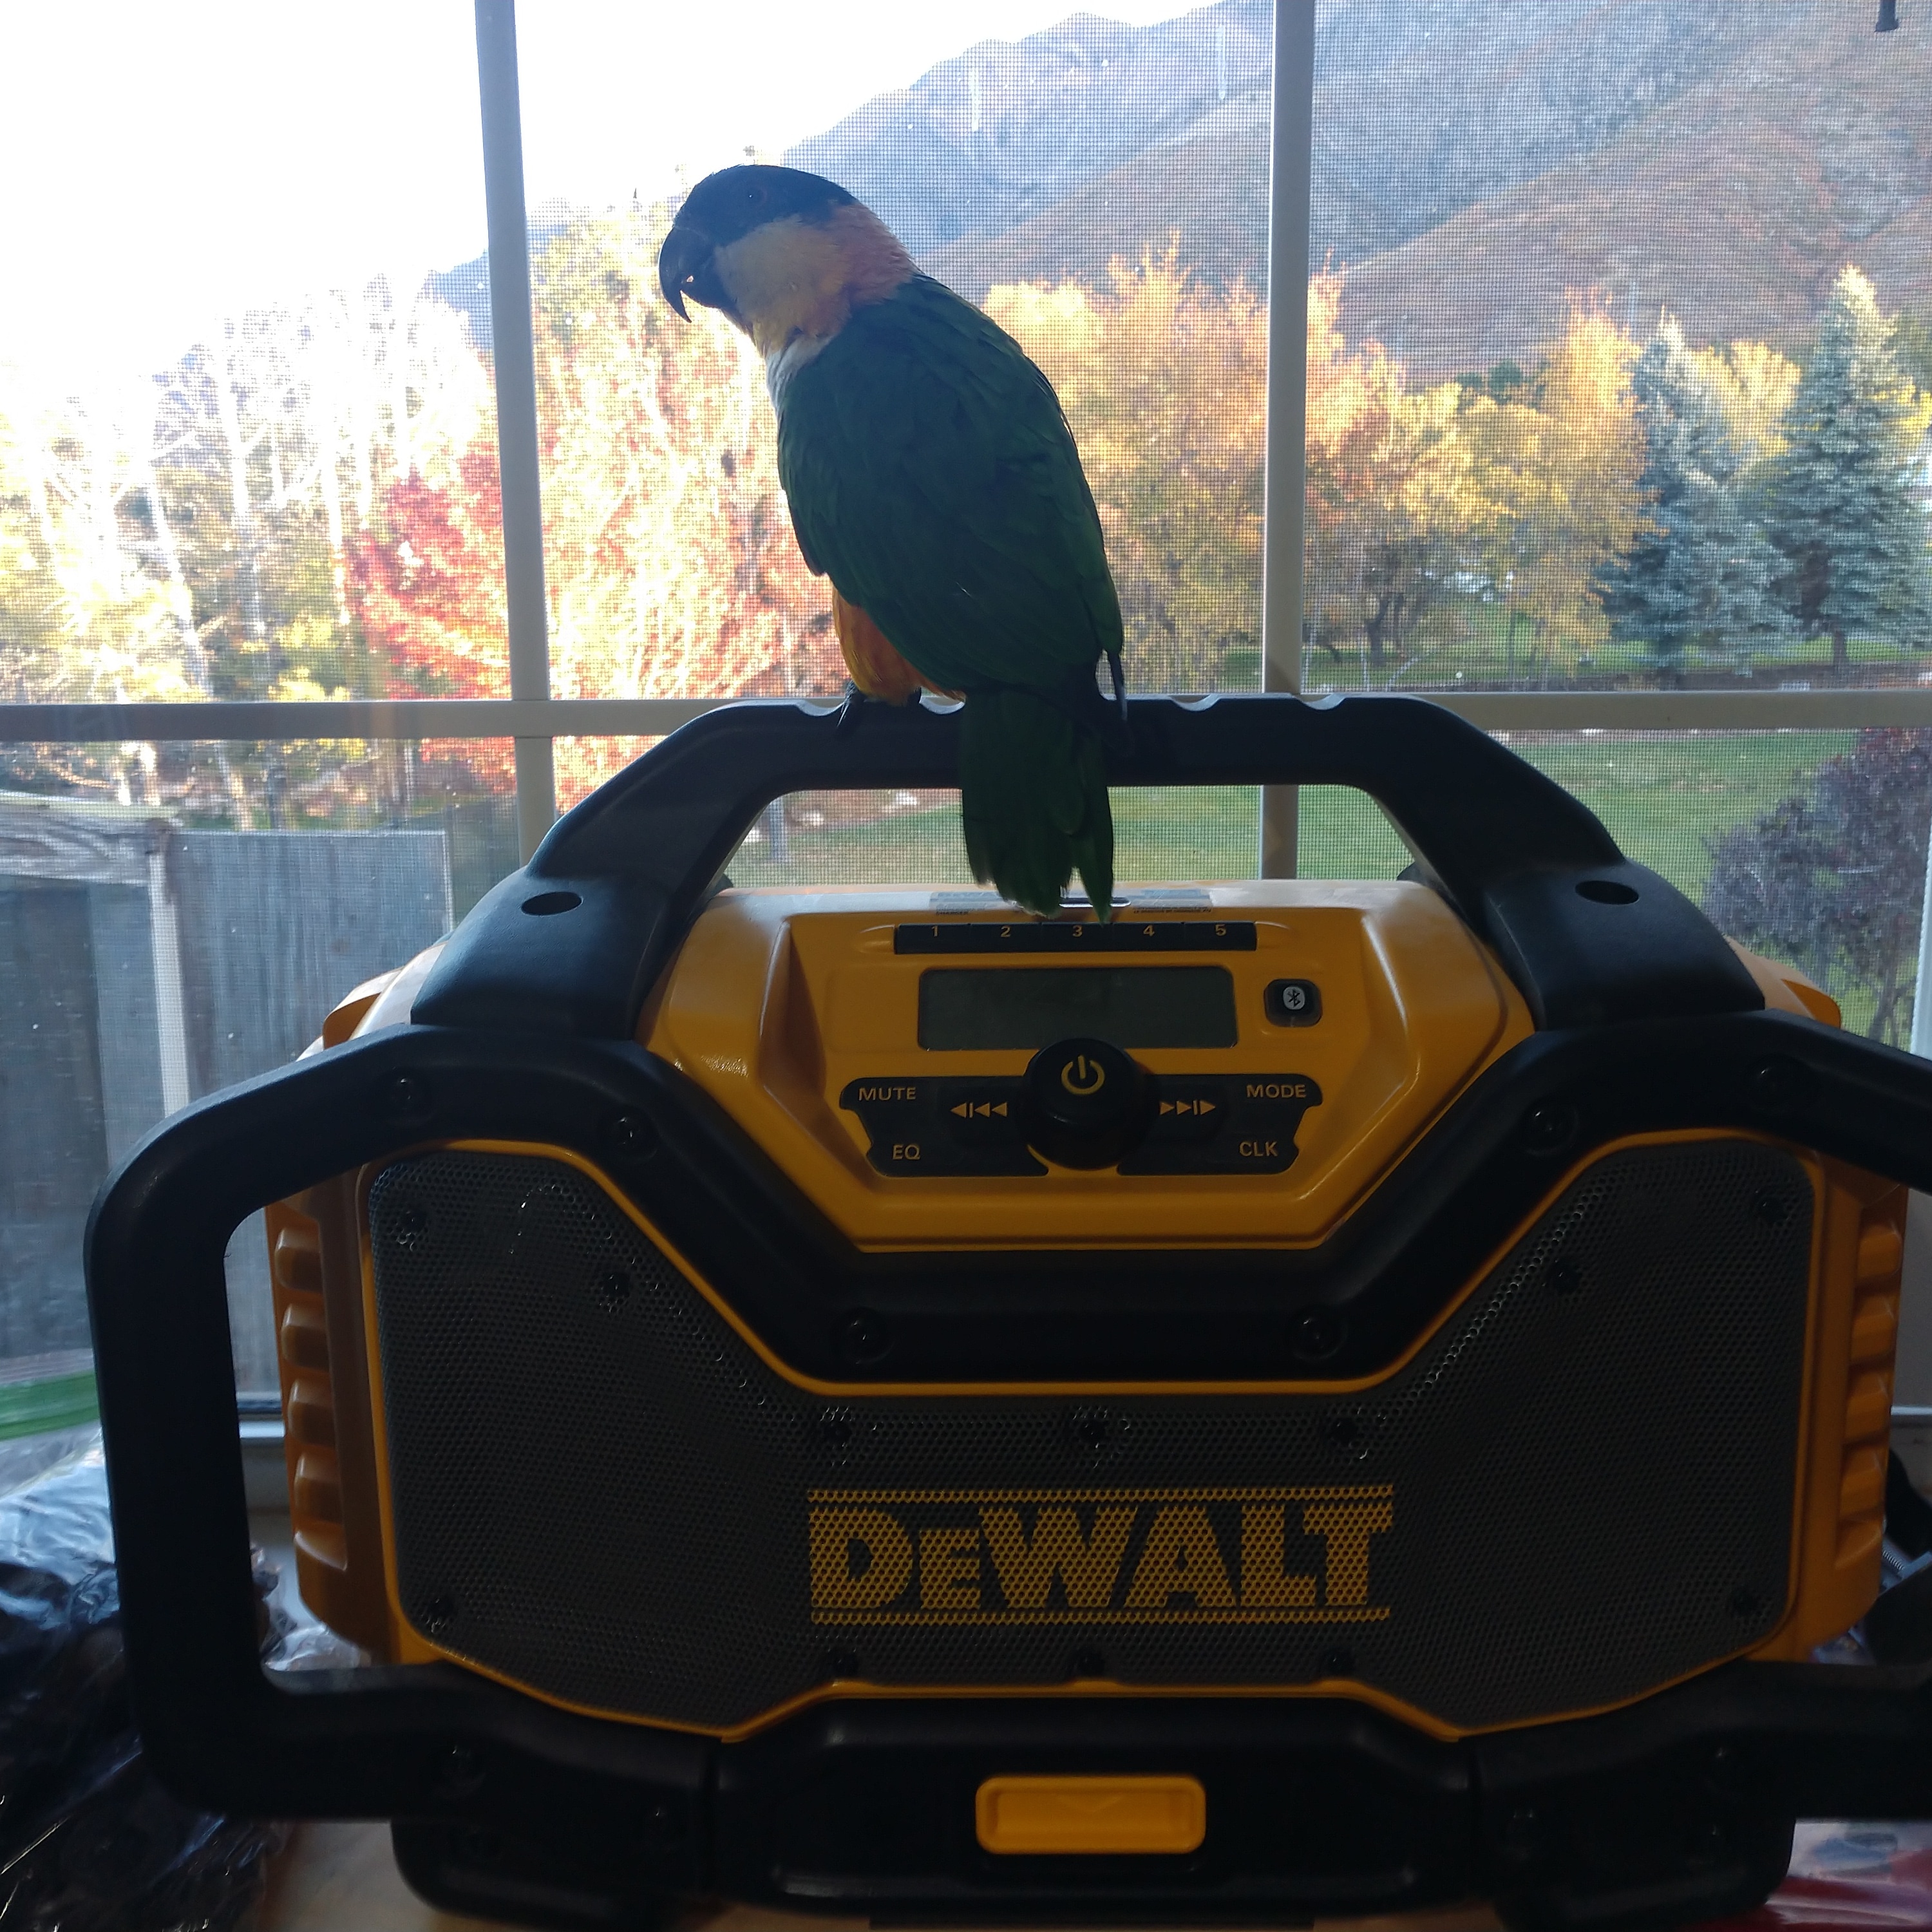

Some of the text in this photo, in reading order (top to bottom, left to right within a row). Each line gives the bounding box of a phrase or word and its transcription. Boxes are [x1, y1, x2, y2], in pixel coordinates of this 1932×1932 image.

[931, 923, 1226, 937] 1 2 3 4 5
[858, 1087, 916, 1101] MUTE
[1246, 1084, 1306, 1098] MODE
[893, 1144, 920, 1160] EQ
[1239, 1141, 1278, 1157] CLK
[808, 1502, 1393, 1610] DEWALT
